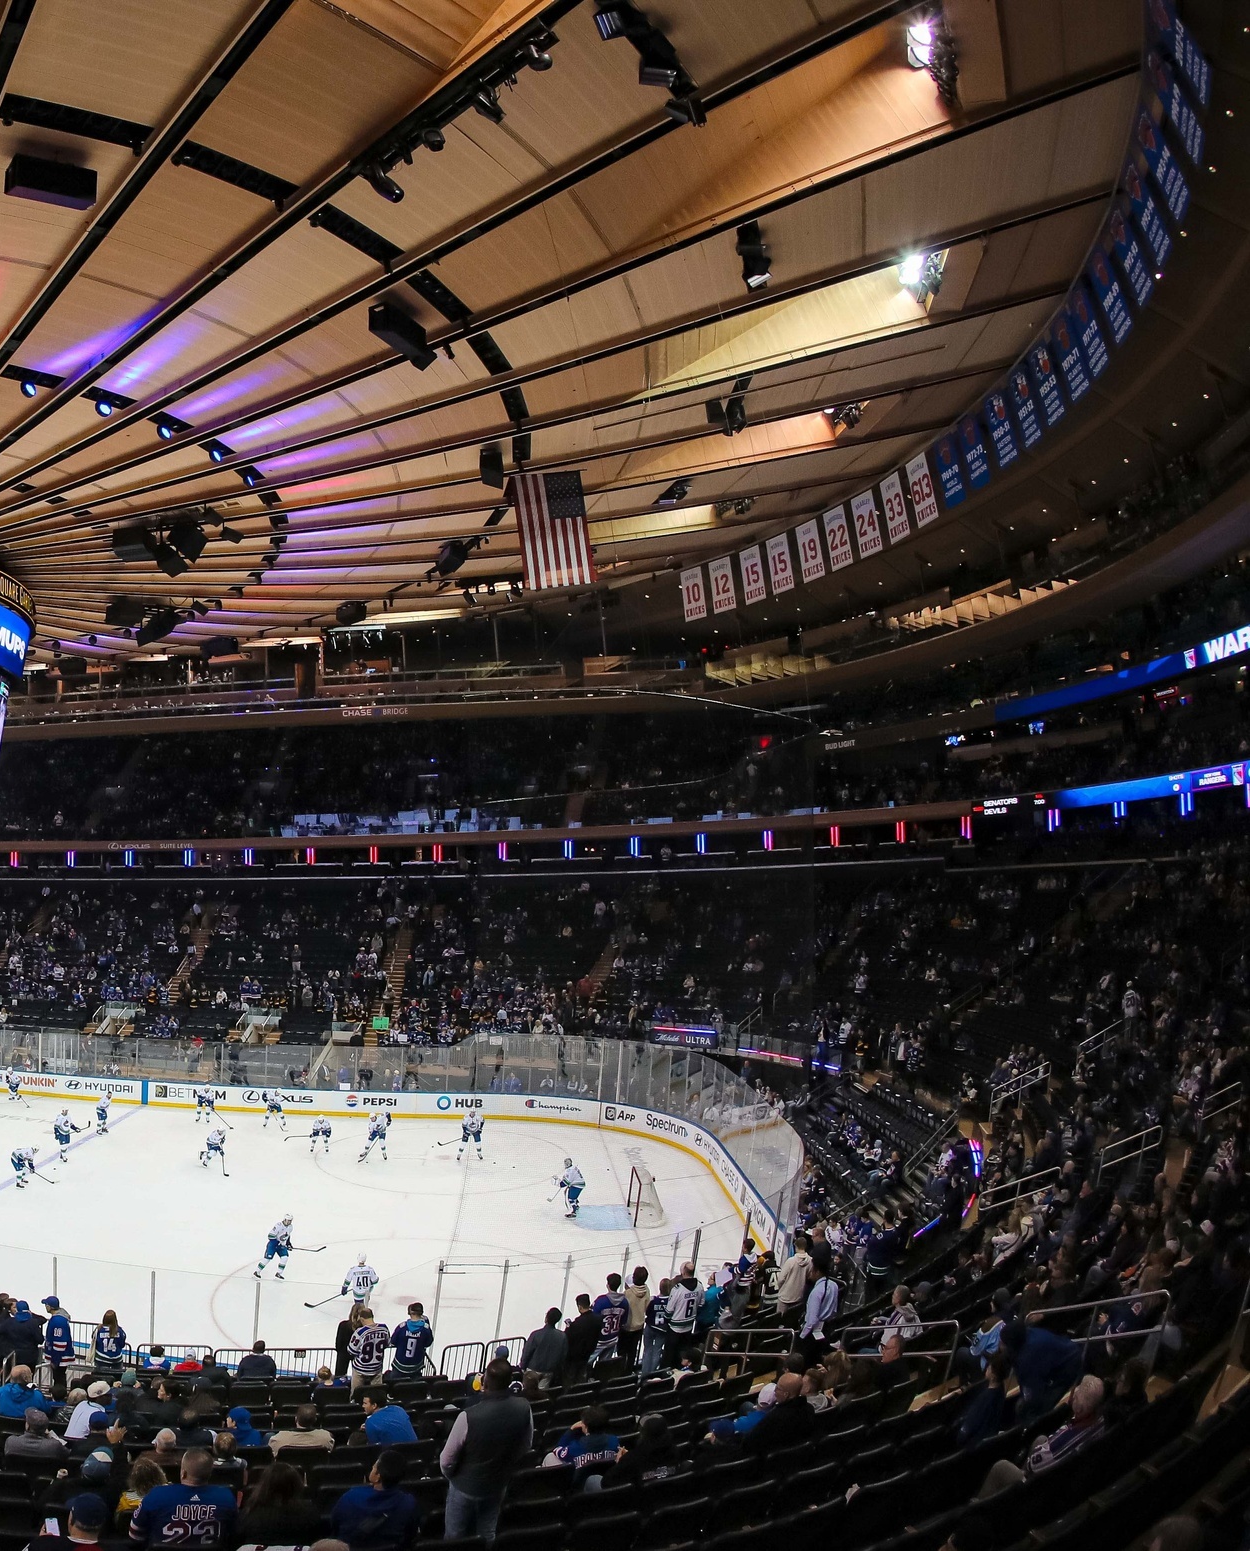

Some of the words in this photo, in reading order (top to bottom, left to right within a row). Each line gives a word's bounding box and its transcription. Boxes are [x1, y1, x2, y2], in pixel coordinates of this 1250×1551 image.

[941, 464, 959, 482] 1969-70
[911, 472, 933, 506] 613
[885, 492, 904, 522] 33
[916, 501, 937, 523] KNICKS
[856, 508, 877, 538] 24
[890, 520, 909, 539] KNICKS
[828, 523, 848, 552] 22
[860, 535, 881, 553] KNICKS
[801, 538, 818, 564] 19
[831, 549, 851, 567] KNICKS
[772, 551, 788, 576] 15
[803, 562, 823, 579] KNICKS
[745, 562, 760, 587] 15
[773, 575, 792, 591] KNICKS
[685, 582, 701, 605] 10
[714, 573, 730, 596] 12
[746, 586, 765, 601] KNICKS
[686, 604, 705, 618] KNICKS
[714, 596, 735, 610] KNICKS
[1203, 626, 1250, 662] WAR
[342, 708, 372, 717] CHASE
[382, 707, 408, 716] BRIDGE
[824, 742, 838, 751] BUD
[838, 739, 856, 749] LIGHT
[1199, 775, 1226, 787] RANGERS
[983, 797, 1018, 808] SENATORS
[983, 807, 1007, 815] DEVILS
[685, 1035, 712, 1045] ULTRA
[84, 1082, 133, 1094] HYUNDAI
[169, 1086, 227, 1101] BETMM
[363, 1097, 398, 1107] PEPSI
[455, 1098, 483, 1108] HUB
[526, 1099, 582, 1113] Champion
[646, 1113, 686, 1137] Spectrum
[356, 1276, 369, 1287] 40
[685, 1298, 696, 1319] 6
[601, 1316, 620, 1336] 31
[295, 1350, 306, 1358] 109
[361, 1340, 386, 1363] 99
[405, 1338, 417, 1358] 9
[171, 1504, 217, 1521] JOYCE
